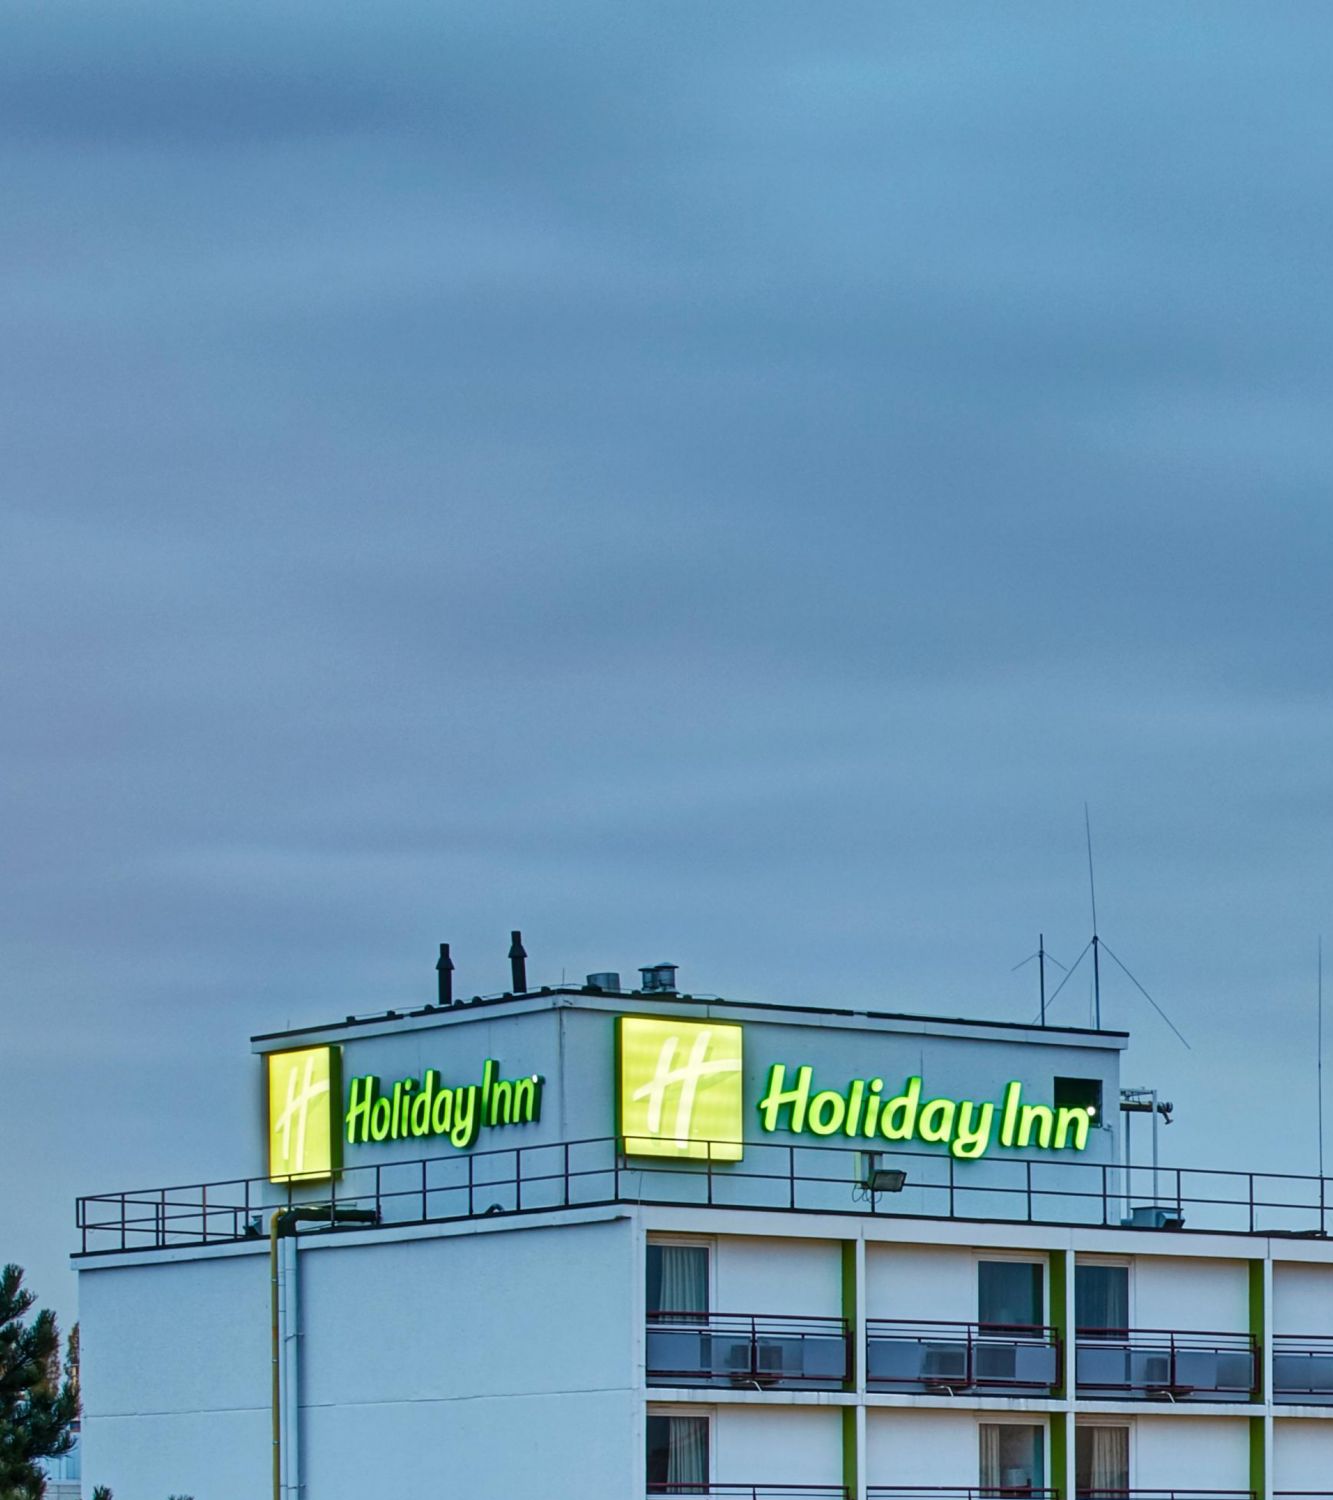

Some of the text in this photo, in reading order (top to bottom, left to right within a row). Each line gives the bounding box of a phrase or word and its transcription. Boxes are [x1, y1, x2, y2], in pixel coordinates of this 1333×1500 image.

[345, 1059, 538, 1149] Holiday Inn
[760, 1063, 1091, 1159] Holiday Inn
